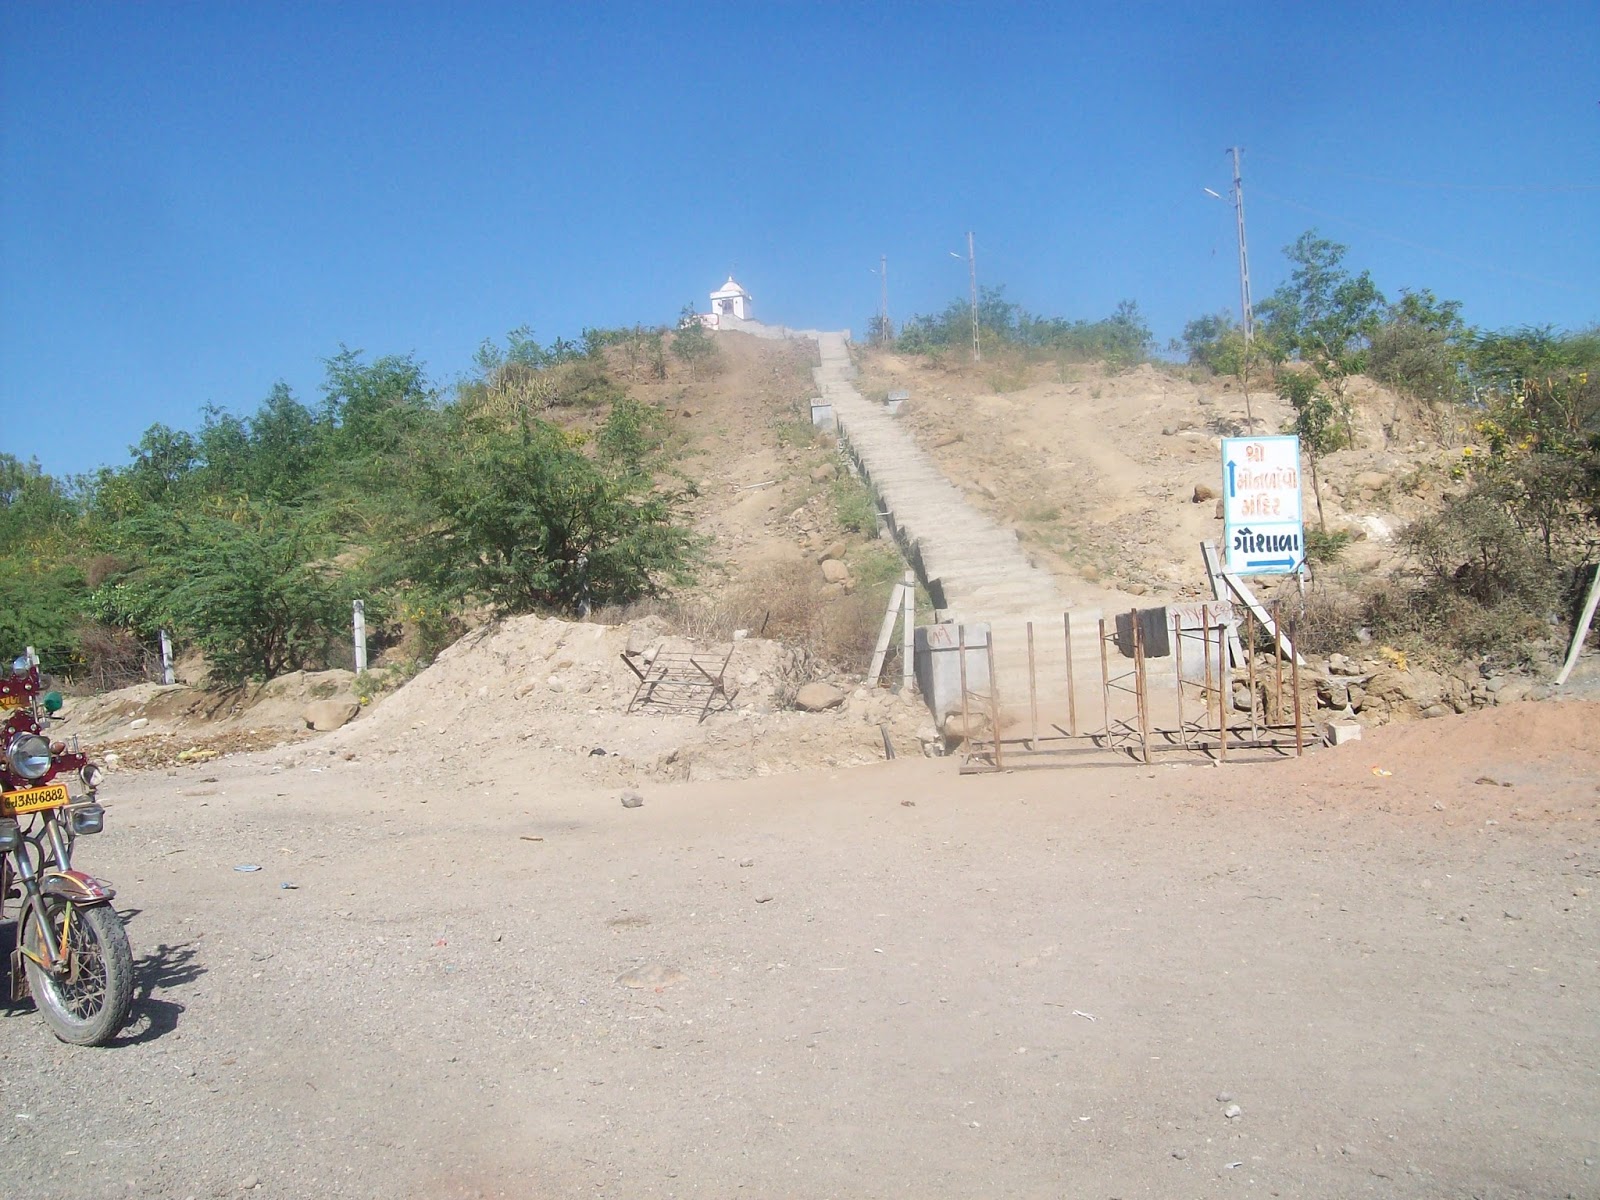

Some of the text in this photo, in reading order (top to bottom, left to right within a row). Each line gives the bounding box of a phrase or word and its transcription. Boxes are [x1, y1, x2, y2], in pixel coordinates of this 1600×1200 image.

[1246, 442, 1265, 462] શ્રી
[1241, 493, 1281, 516] મંદિર
[1234, 527, 1299, 553] ગૌશાળા
